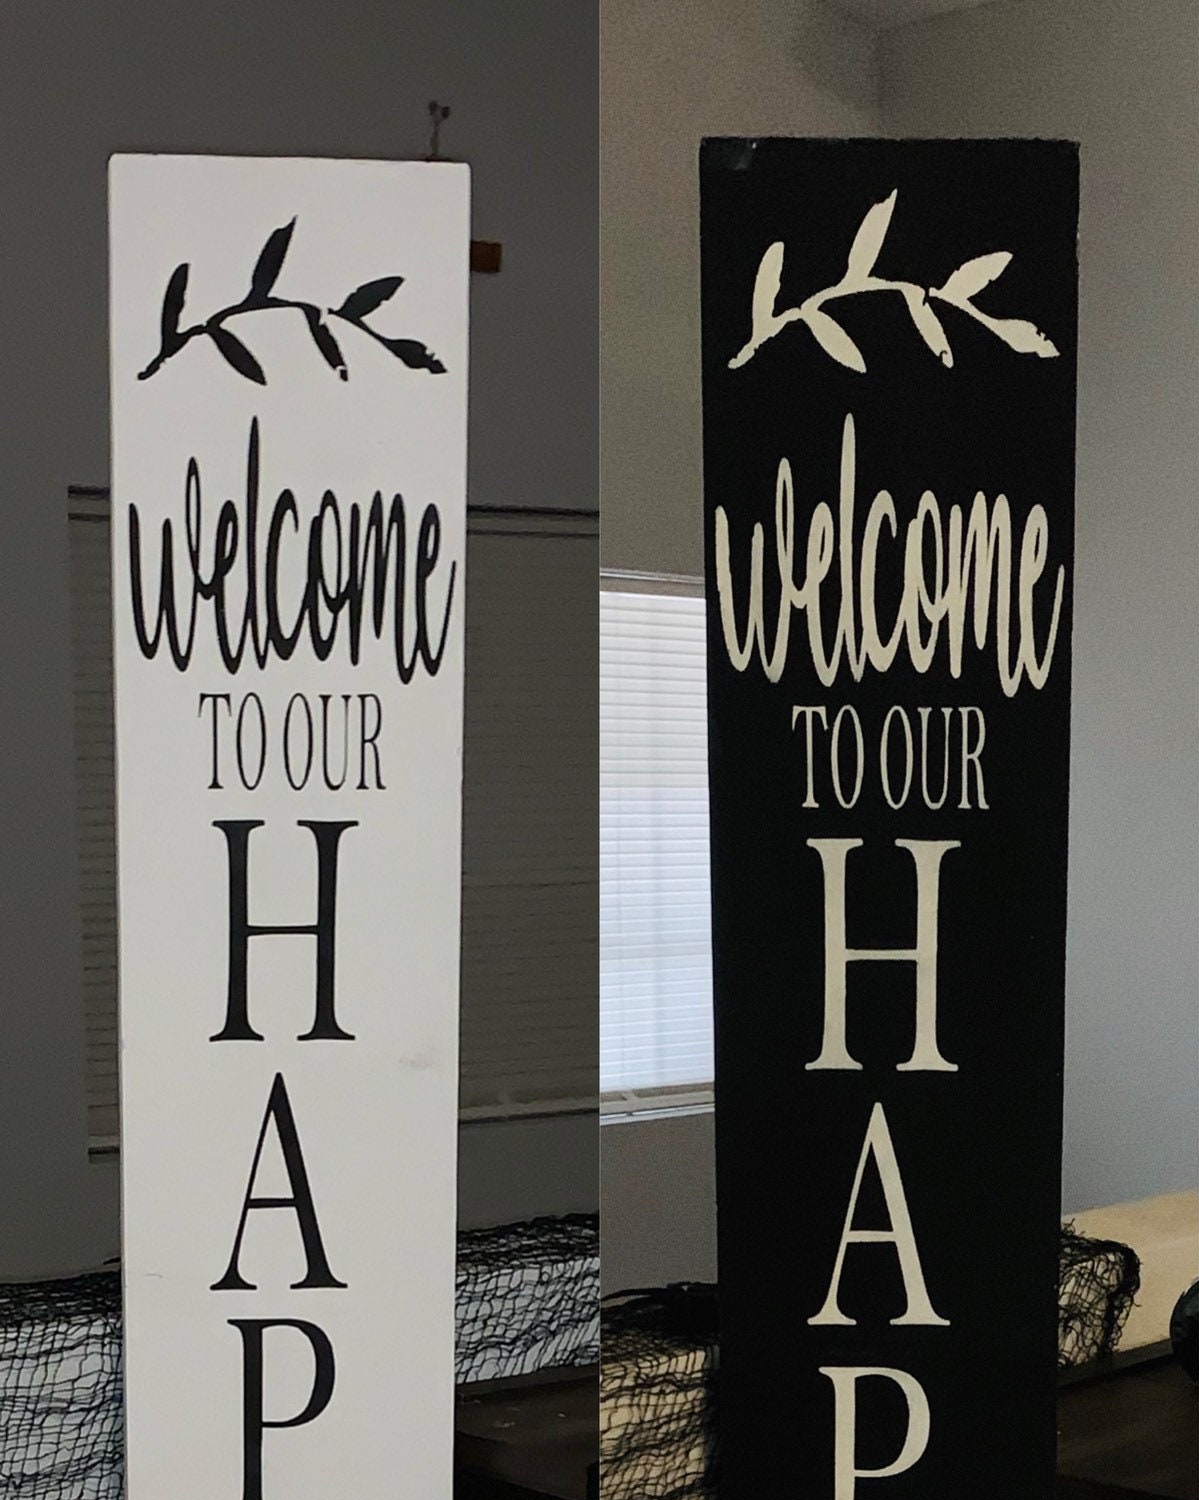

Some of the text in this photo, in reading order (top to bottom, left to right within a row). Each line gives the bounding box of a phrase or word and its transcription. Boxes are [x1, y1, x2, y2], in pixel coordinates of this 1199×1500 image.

[199, 692, 386, 791] TO OUR
[792, 705, 989, 809] TO OUR
